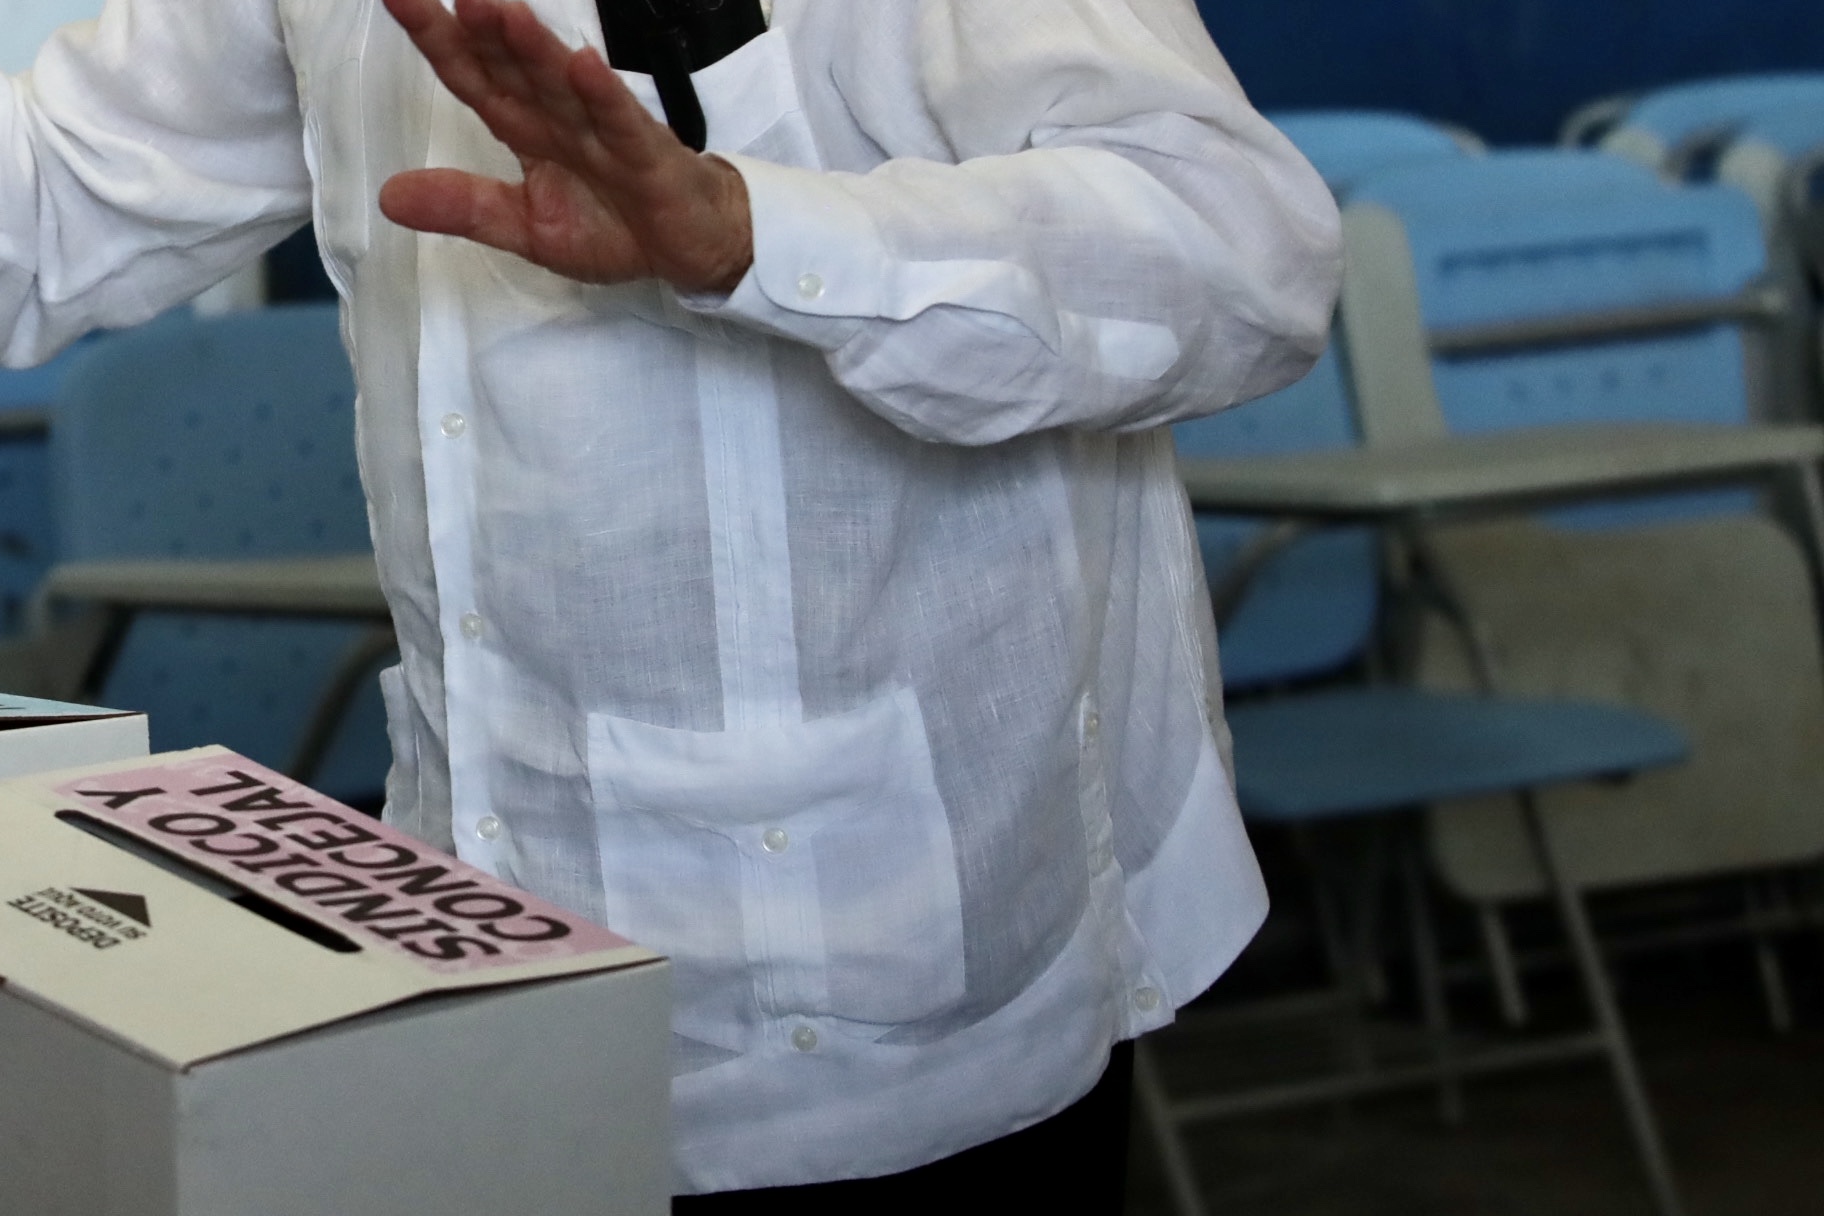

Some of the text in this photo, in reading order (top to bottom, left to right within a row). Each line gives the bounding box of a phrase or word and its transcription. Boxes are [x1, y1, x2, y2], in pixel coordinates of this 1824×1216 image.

[75, 786, 502, 961] SINDICO Y
[190, 769, 572, 943] CONCEJAL
[6, 895, 122, 950] DEPOSITE
[77, 905, 123, 930] VOTO
[117, 926, 148, 940] SU
